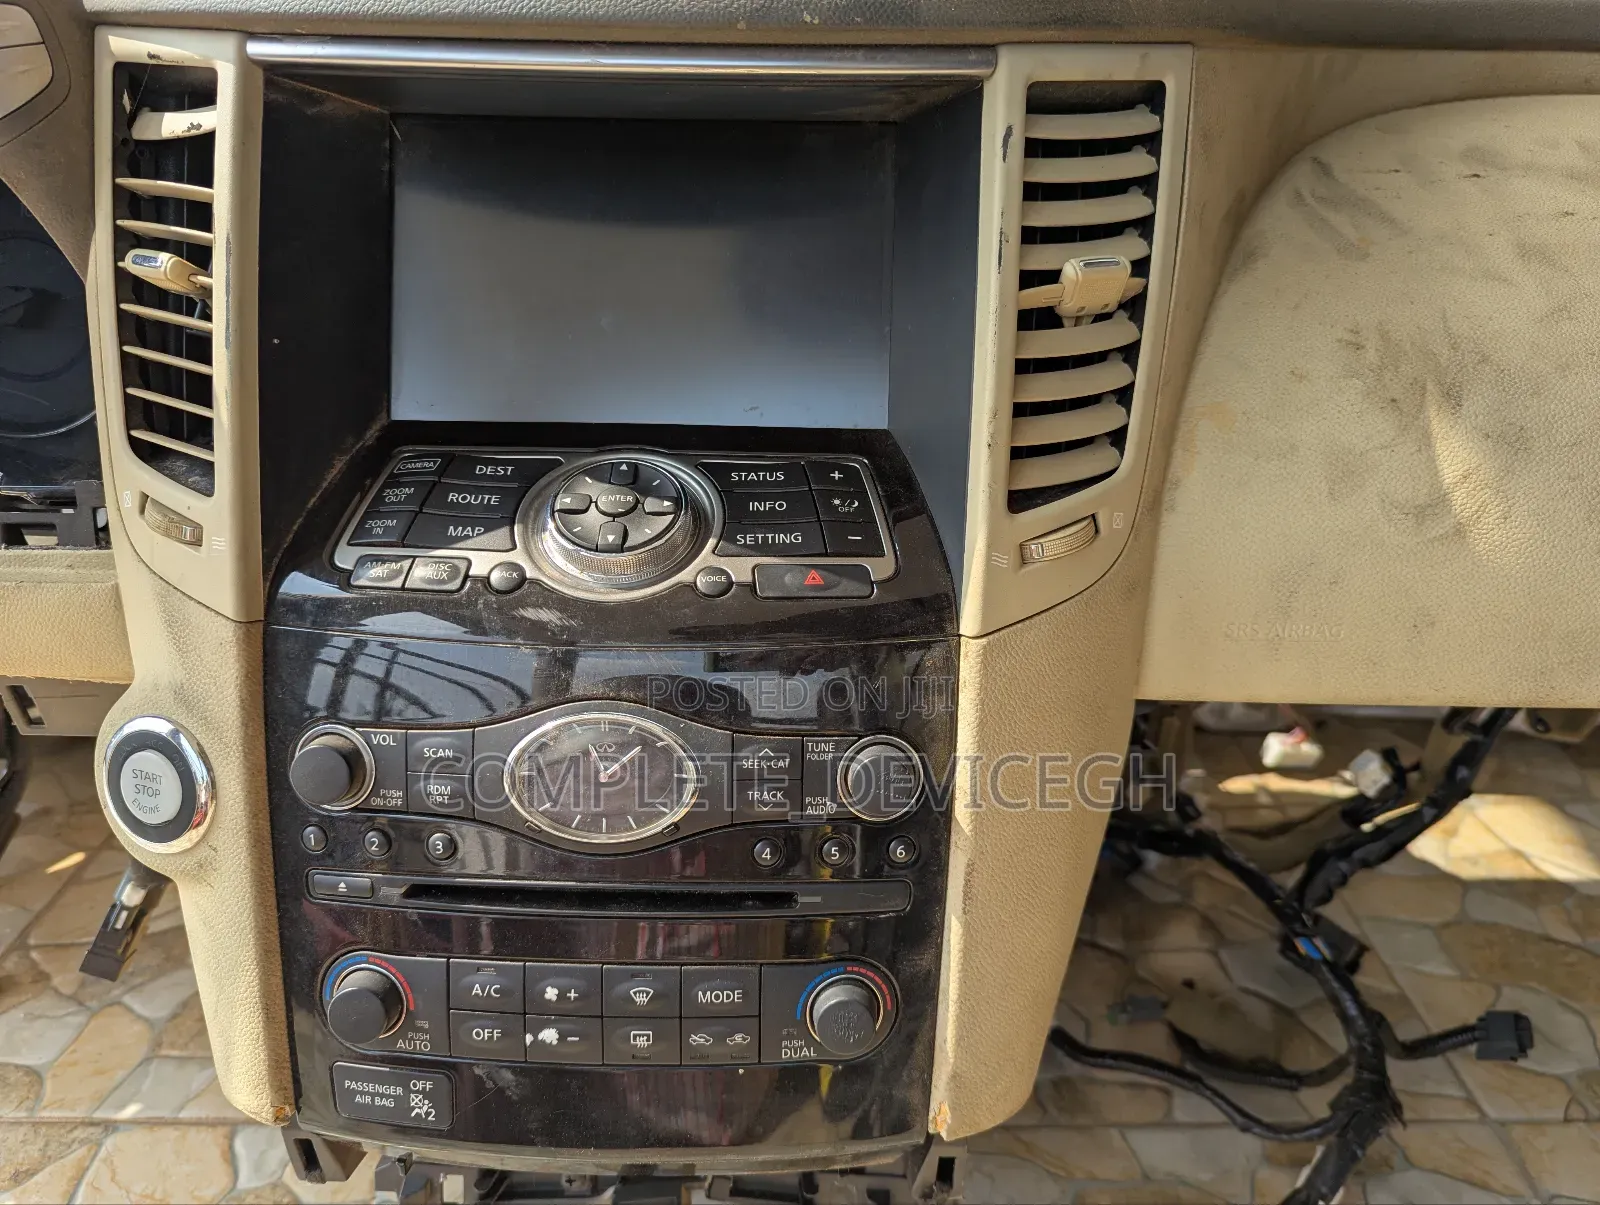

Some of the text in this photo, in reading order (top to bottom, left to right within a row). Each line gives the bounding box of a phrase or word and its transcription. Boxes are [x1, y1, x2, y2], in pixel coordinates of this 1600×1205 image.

[400, 461, 434, 470] CAMERA
[475, 465, 515, 476] DEST
[730, 471, 785, 481] STATUS
[382, 487, 415, 496] ZOOM
[448, 493, 501, 505] ROUTE
[601, 495, 634, 503] ENTER
[749, 501, 787, 512] INFO
[365, 519, 397, 528] ZOOM
[372, 527, 384, 535] IN
[447, 525, 485, 537] MAP
[736, 533, 802, 545] SETTING
[428, 563, 453, 571] DISC
[369, 569, 389, 578] SAT
[425, 571, 449, 580] AUX
[496, 571, 519, 579] ACK
[700, 574, 727, 583] VOICE
[371, 734, 397, 746] VOL
[807, 742, 836, 752] TUNE
[423, 748, 453, 758] SCAN
[132, 769, 163, 786] START
[134, 784, 160, 799] STOP
[380, 789, 403, 798] PUSH
[427, 785, 451, 795] RDM
[747, 791, 784, 801] TRACK
[132, 798, 161, 815] ENGINE
[806, 805, 836, 814] AUDIO
[309, 833, 315, 846] 1
[370, 839, 379, 850] 2
[435, 841, 443, 854] 3
[897, 845, 905, 858] 6
[762, 847, 771, 860] 4
[831, 847, 840, 860] 5
[472, 984, 501, 997] A/C
[698, 990, 743, 1003] MODE
[408, 1032, 430, 1040] PUSH
[472, 1029, 501, 1040] OFF
[396, 1039, 431, 1051] AUTO
[782, 1039, 805, 1048] PUSH
[782, 1047, 818, 1058] DUAL
[344, 1080, 403, 1096] PASSENGER
[410, 1080, 433, 1092] OFF
[355, 1094, 395, 1107] AIR BAG
